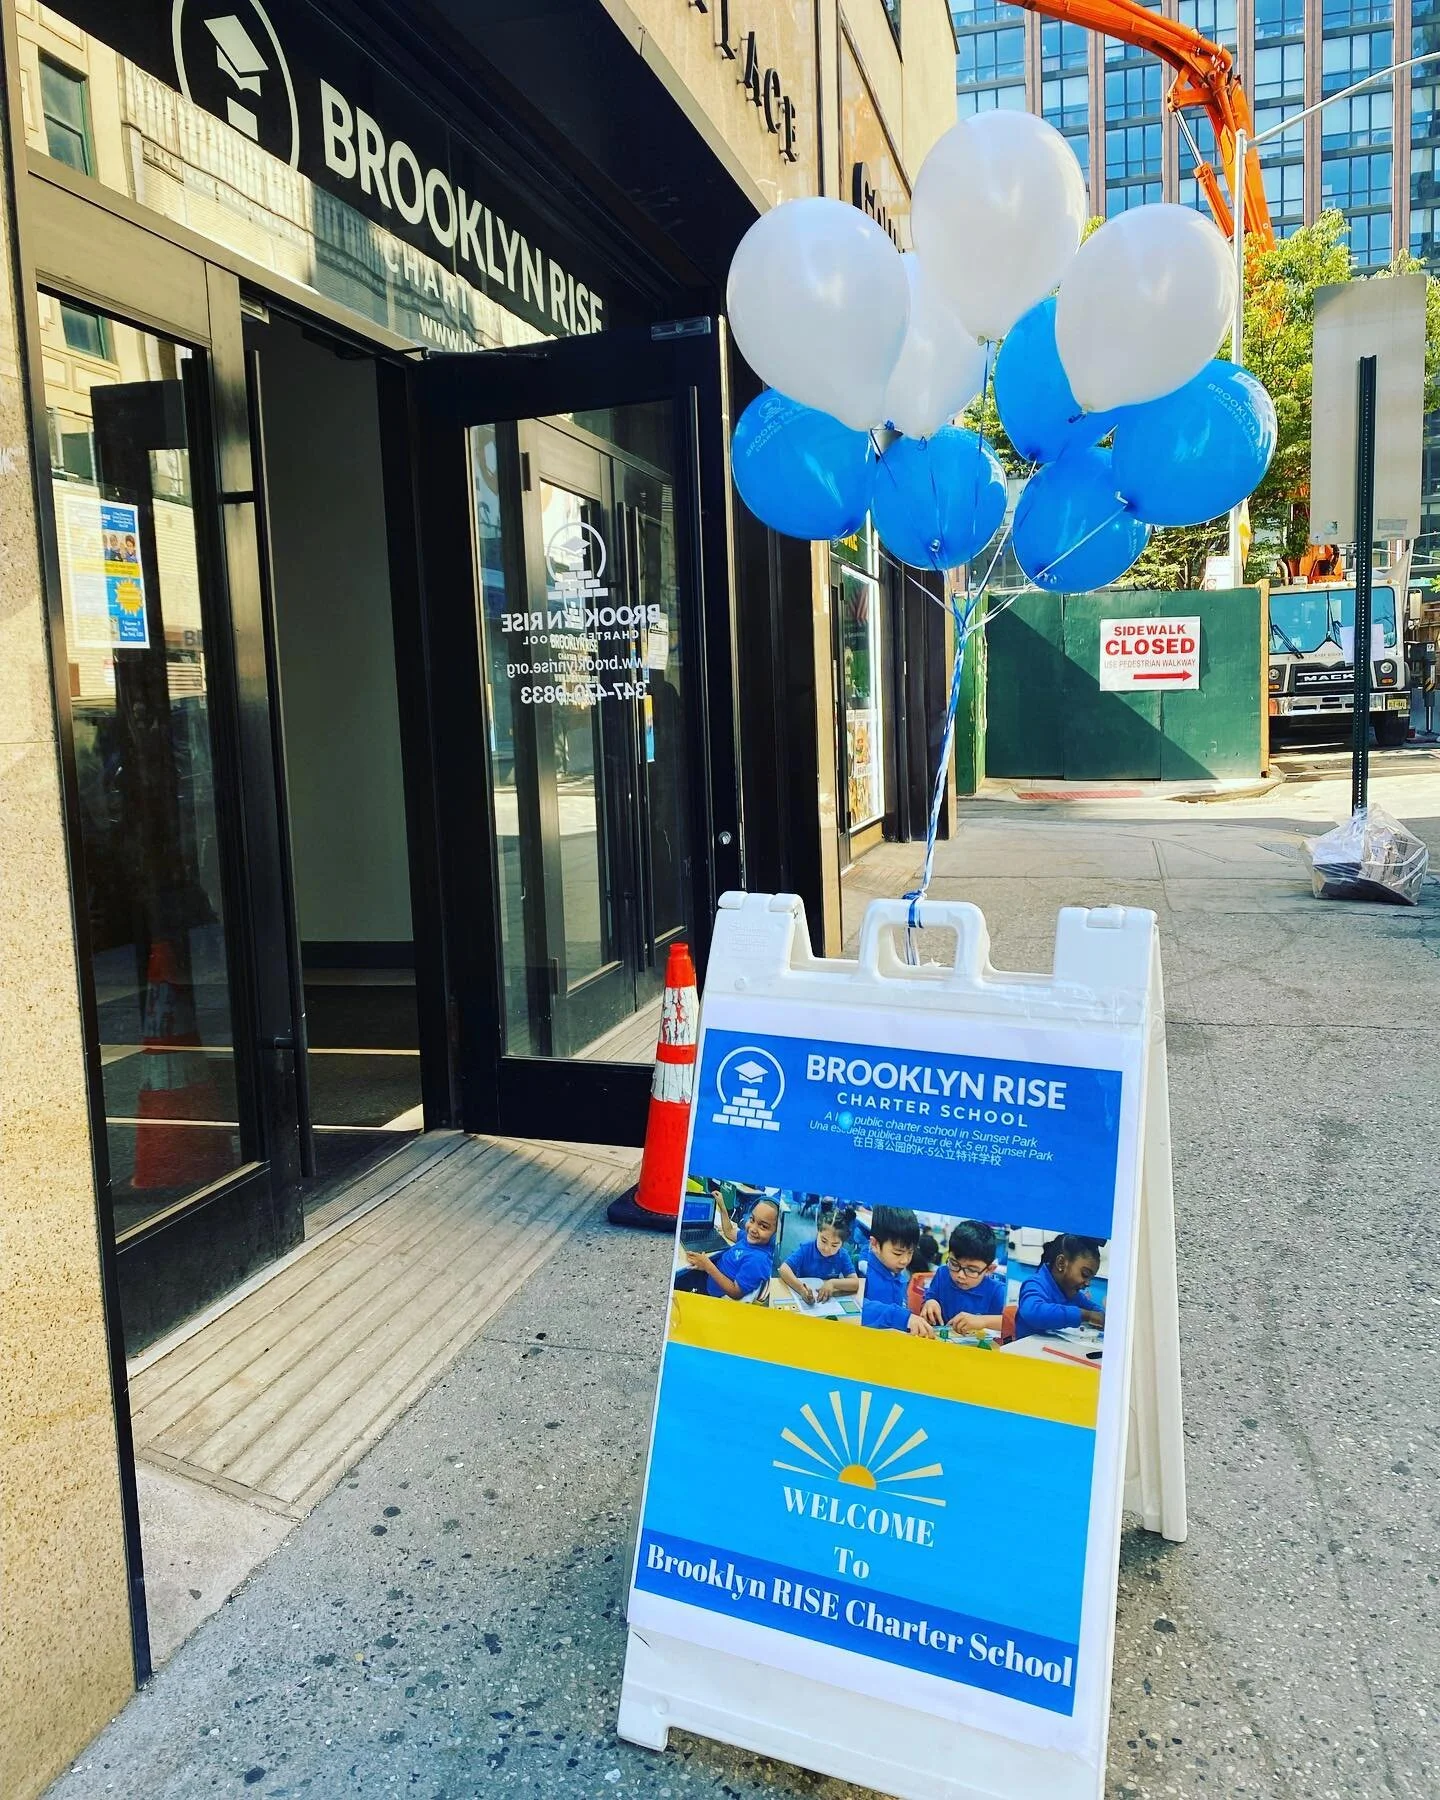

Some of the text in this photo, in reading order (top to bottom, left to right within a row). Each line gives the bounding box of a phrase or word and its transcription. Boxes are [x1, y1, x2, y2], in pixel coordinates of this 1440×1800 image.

[320, 78, 603, 336] BROOKLYN RISE
[1105, 638, 1195, 656] CLOSED
[1114, 624, 1186, 636] SIDEWALK
[1104, 659, 1196, 669] USE PEDESTRIAN WALKWAY
[1304, 673, 1354, 682] MACK
[807, 1054, 1067, 1110] BROOKLYN RISE
[837, 1092, 1028, 1128] CHARTER SCHOOL
[810, 1120, 829, 1132] Una
[868, 1127, 902, 1141] pública
[904, 1133, 937, 1146] charter
[940, 1138, 952, 1148] de
[955, 1140, 973, 1151] K-5
[974, 1144, 988, 1153] en
[991, 1144, 1027, 1158] Sunset
[1029, 1149, 1054, 1162] Park
[824, 1111, 833, 1121] A
[854, 1115, 884, 1127] public
[886, 1119, 921, 1132] charter
[923, 1125, 957, 1137] school
[959, 1129, 969, 1139] in
[972, 1130, 1010, 1144] Sunset
[1012, 1135, 1038, 1148] Park
[782, 1485, 935, 1548] WELCOME
[833, 1546, 870, 1579] To
[646, 1543, 1073, 1688] Brooklyn RISE Charter School
